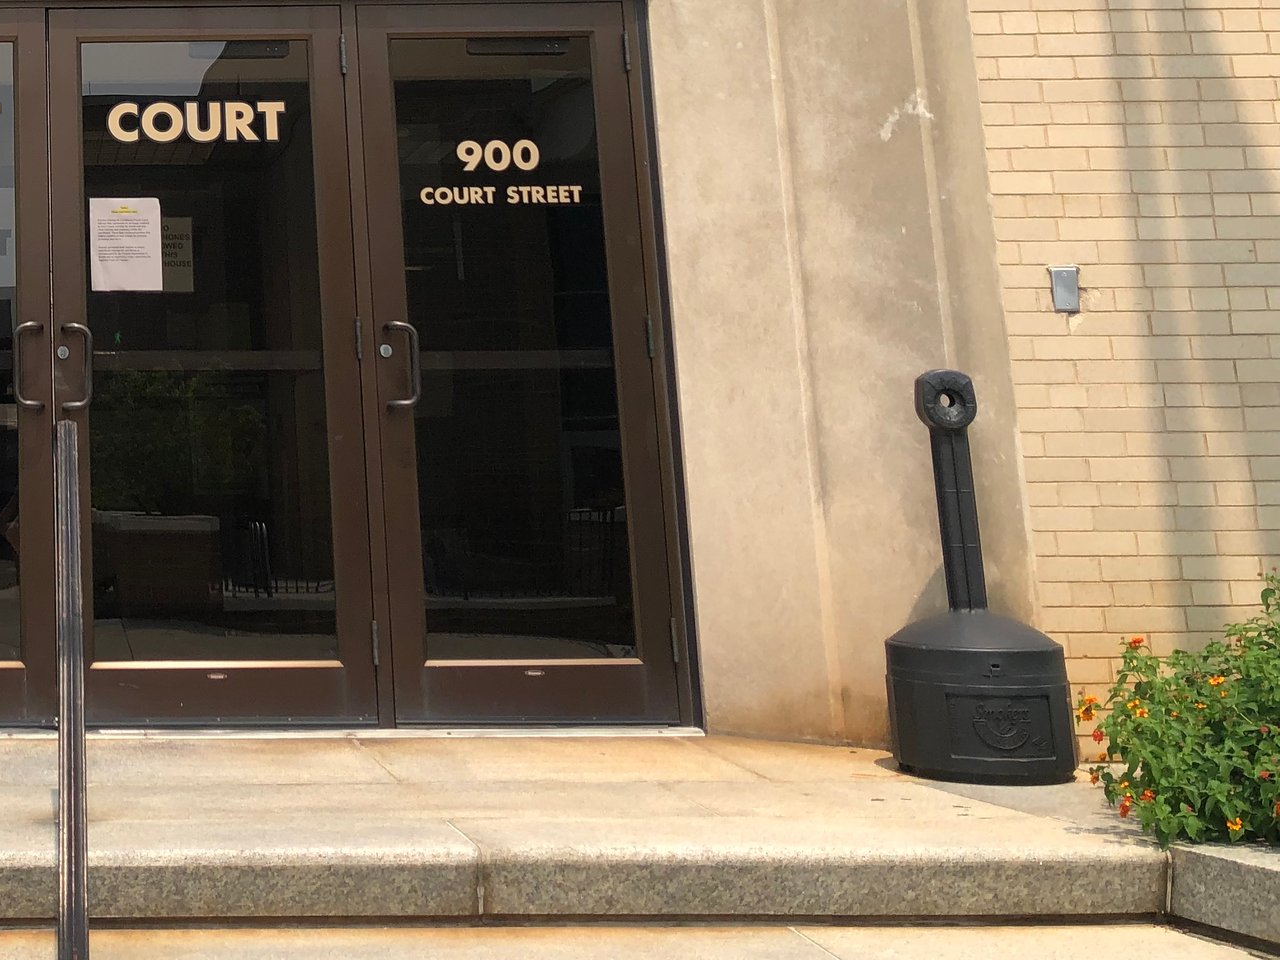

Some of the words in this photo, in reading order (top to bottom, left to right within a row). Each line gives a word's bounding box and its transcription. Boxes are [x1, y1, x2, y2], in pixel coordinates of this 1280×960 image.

[106, 100, 286, 143] COURT
[456, 138, 541, 172] 900
[420, 186, 497, 206] COURT
[506, 184, 583, 205] STREET
